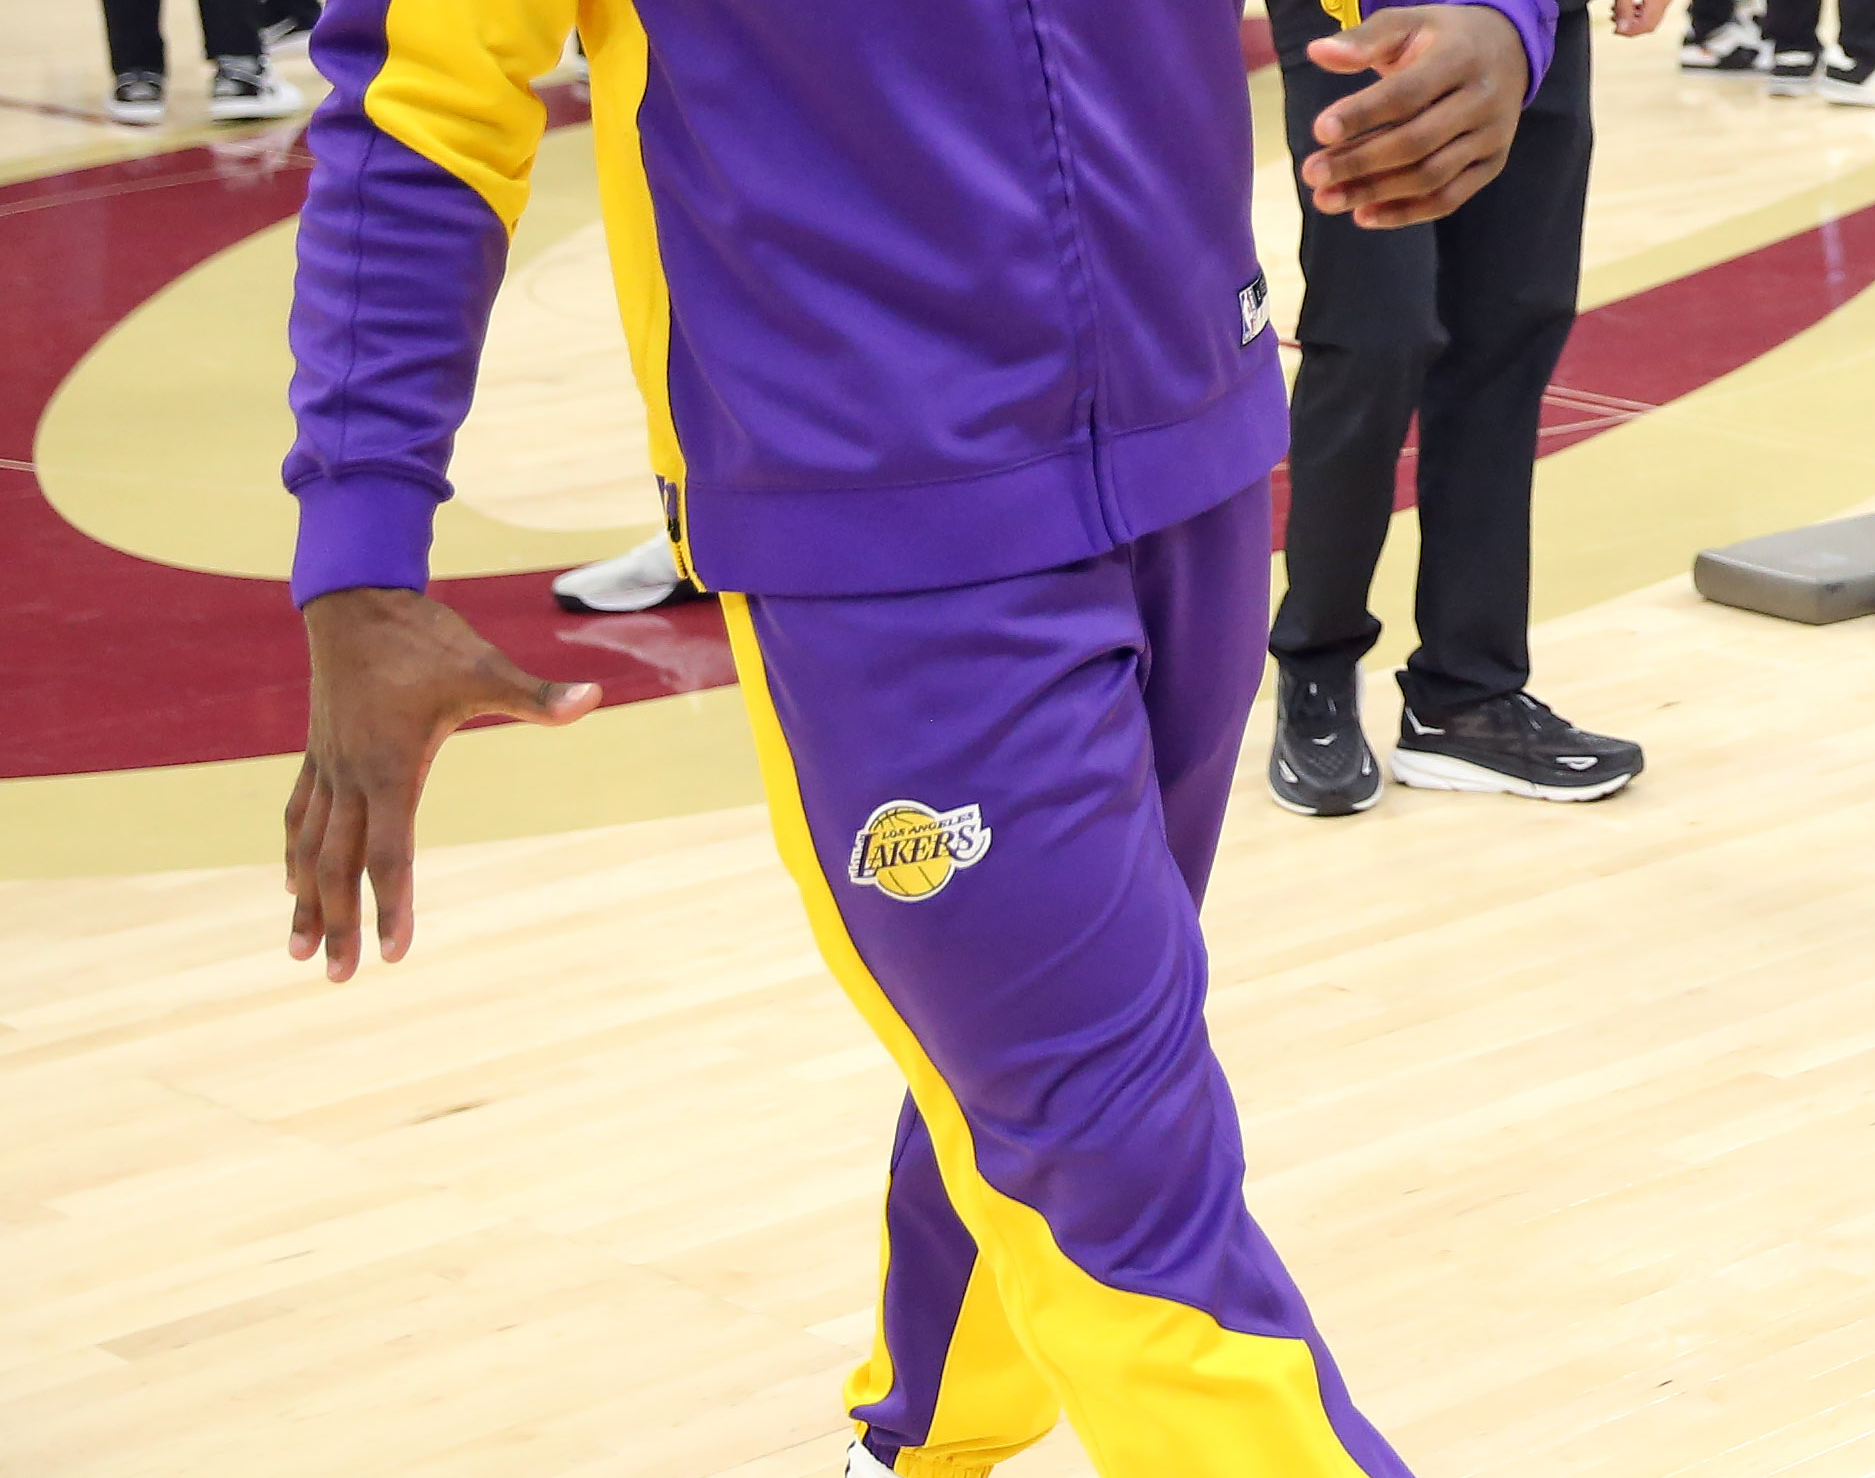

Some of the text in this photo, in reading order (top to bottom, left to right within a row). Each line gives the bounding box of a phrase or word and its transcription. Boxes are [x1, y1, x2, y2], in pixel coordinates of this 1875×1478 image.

[882, 811, 975, 841] LOS ANGELES
[854, 824, 985, 878] LAKERS
